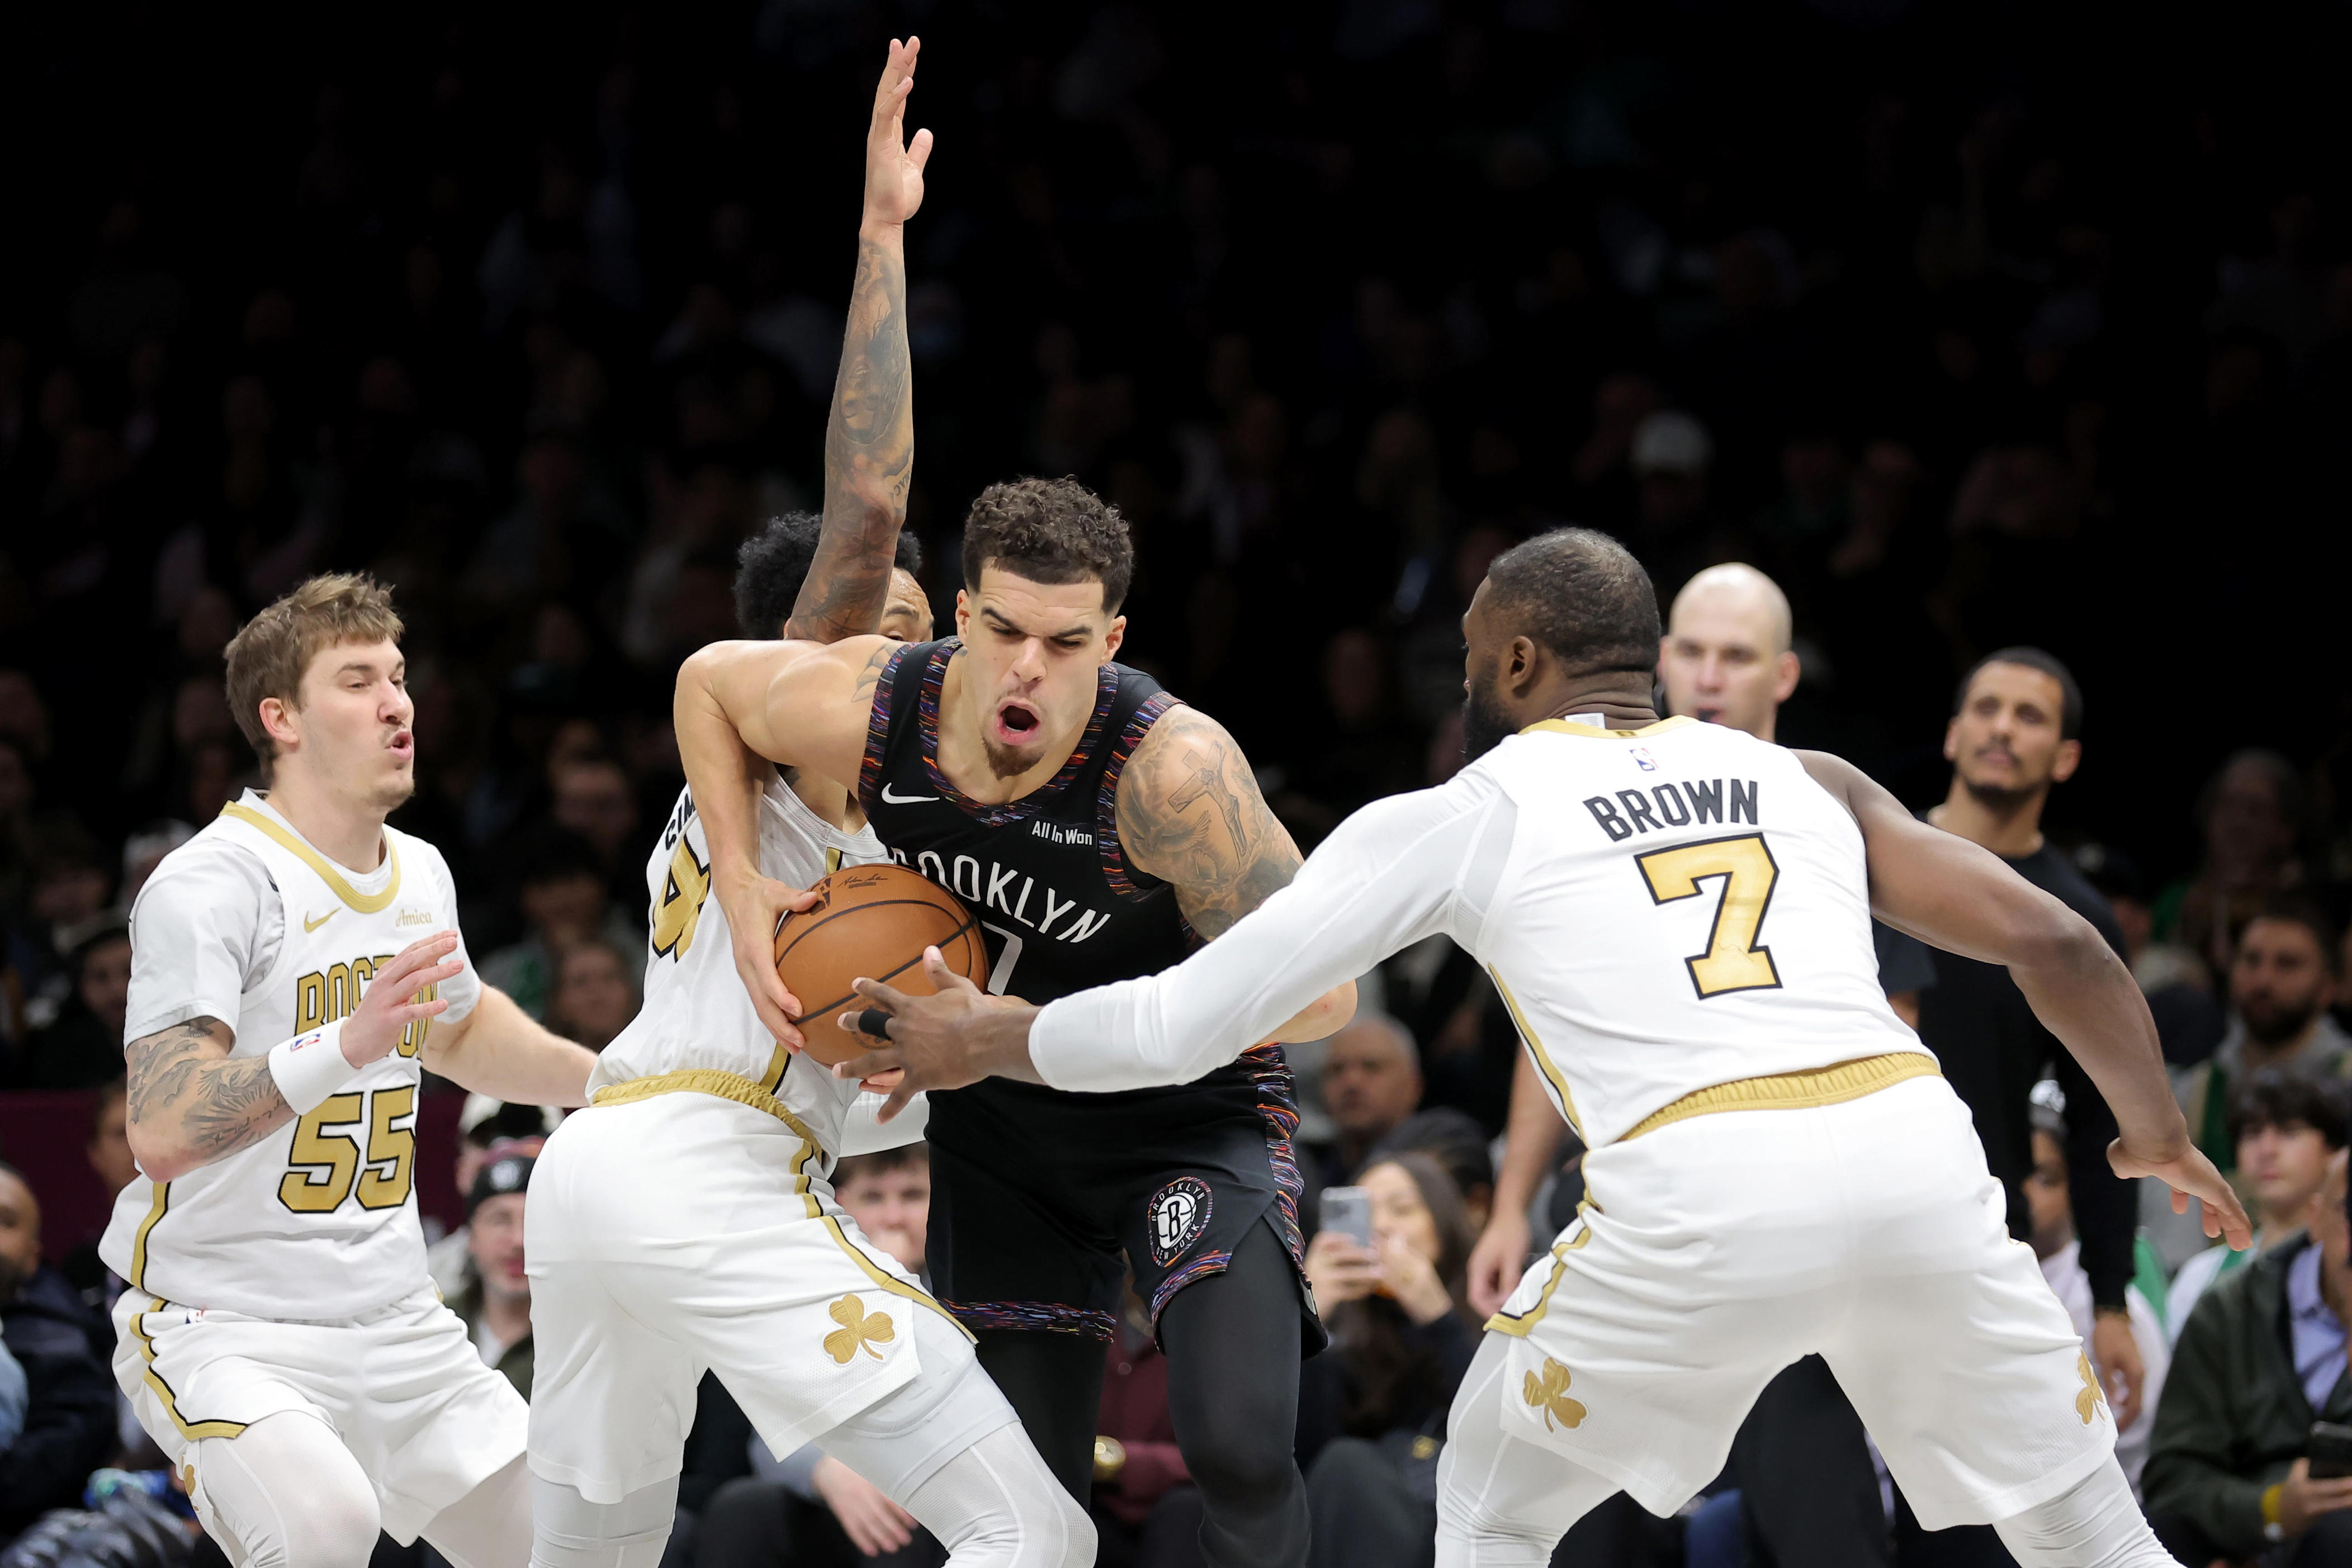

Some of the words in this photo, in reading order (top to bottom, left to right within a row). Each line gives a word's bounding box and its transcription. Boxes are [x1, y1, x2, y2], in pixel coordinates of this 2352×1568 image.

[1031, 820, 1050, 839] All
[1051, 825, 1063, 844] In
[1065, 828, 1093, 846] Won
[1583, 778, 1758, 842] BROWN
[395, 908, 433, 927] Amica
[652, 832, 712, 964] 4
[1633, 832, 1783, 1001] 7
[277, 1084, 417, 1214] 55
[1151, 1182, 1205, 1221] BROOKLYN
[1156, 1246, 1170, 1261] NEW
[1173, 1224, 1200, 1254] YORK
